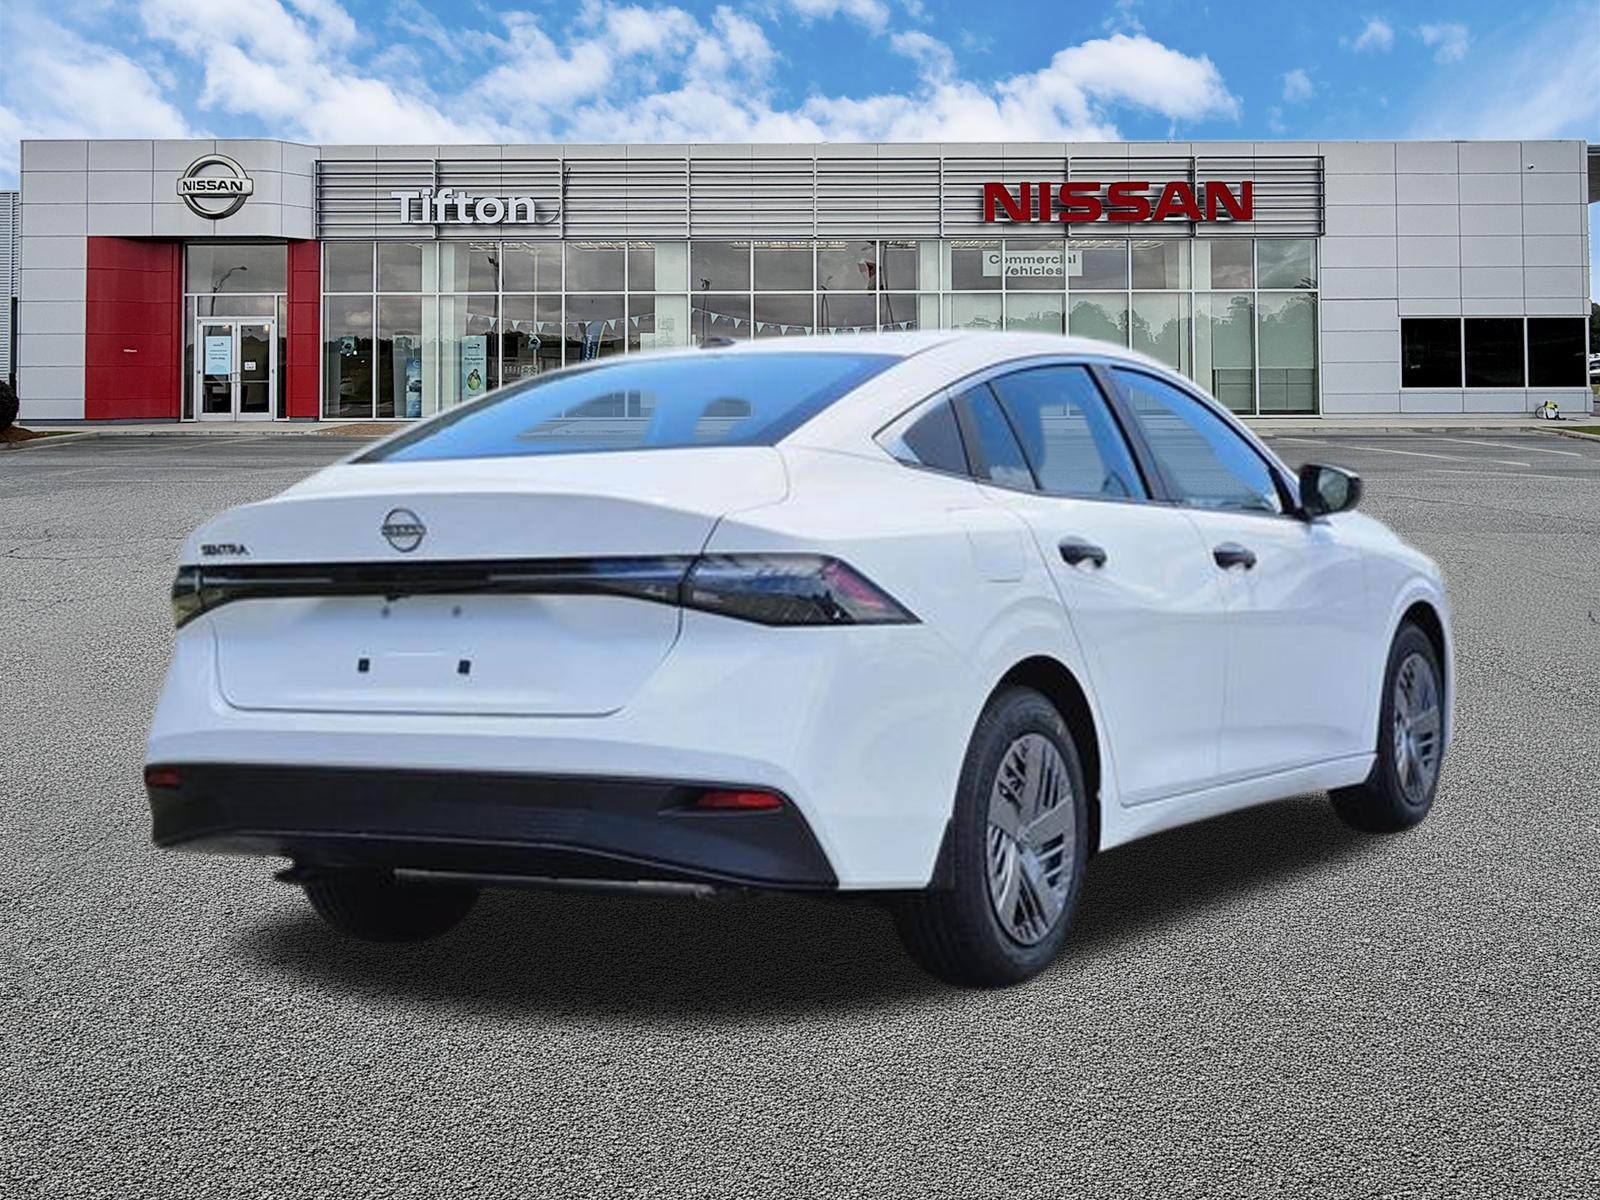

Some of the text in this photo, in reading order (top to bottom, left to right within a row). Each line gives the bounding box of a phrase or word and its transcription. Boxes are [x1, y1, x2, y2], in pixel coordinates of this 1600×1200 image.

[182, 180, 243, 192] NISSAN
[984, 181, 1253, 222] NISSAN
[391, 188, 536, 224] Tifton
